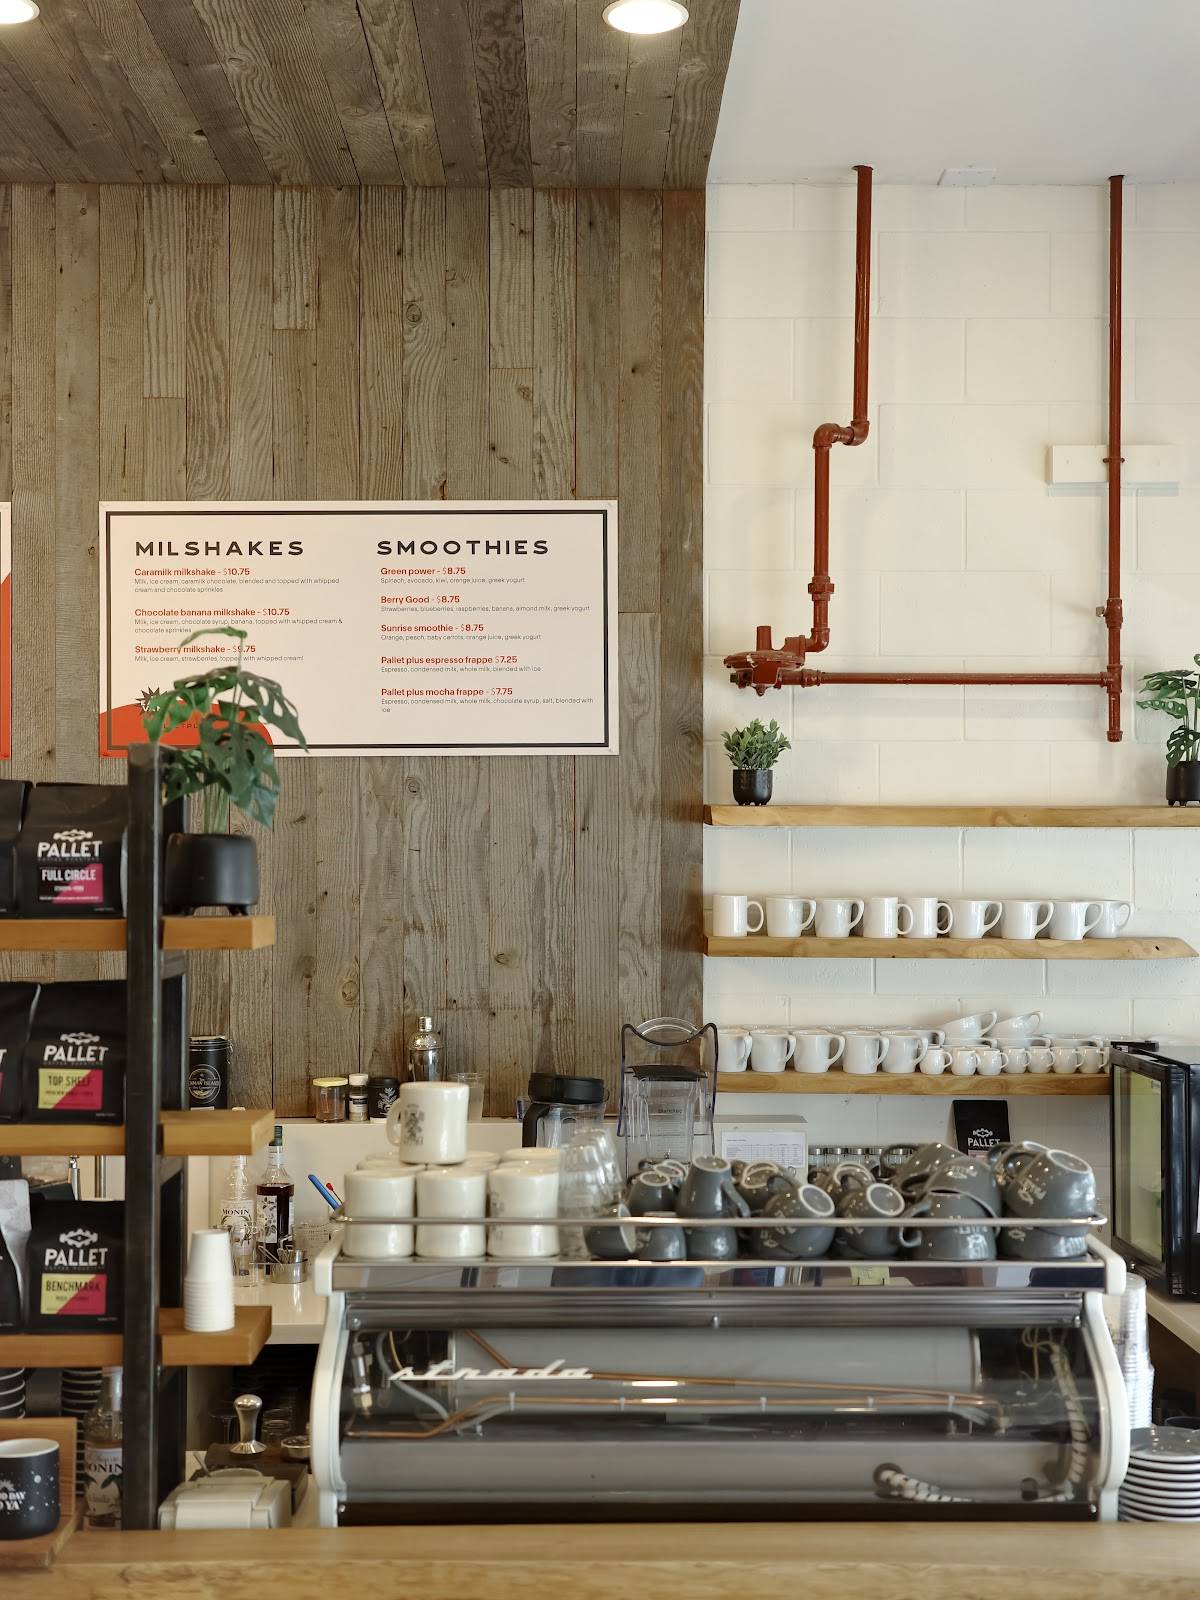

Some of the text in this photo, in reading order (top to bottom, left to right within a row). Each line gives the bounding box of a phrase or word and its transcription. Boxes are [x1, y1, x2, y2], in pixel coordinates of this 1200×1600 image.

[136, 541, 303, 556] MILSHAKES
[377, 540, 548, 555] SMOOTHIES
[223, 567, 250, 576] $10.75
[442, 567, 466, 575] $8.75
[381, 595, 404, 604] Berry
[405, 595, 430, 603] Good
[436, 595, 460, 604] $8.75
[134, 608, 179, 616] Chocolate
[180, 608, 212, 616] banana
[213, 608, 256, 616] milkshake
[262, 608, 290, 617] $10.75
[460, 624, 484, 632] $8.75
[134, 645, 181, 654] Strawberry
[406, 656, 424, 665] plus
[465, 656, 494, 665] frappe
[495, 656, 518, 664] $7.25
[406, 688, 424, 697] plus
[456, 688, 484, 697] frappe
[491, 688, 513, 696] $7.75
[37, 841, 102, 858] PALLET
[42, 869, 96, 881] FULL CIRCLE
[44, 1045, 109, 1062] PALLET
[48, 1075, 63, 1086] TOP
[968, 1138, 1000, 1147] PALLET
[45, 1248, 108, 1266] PALLET
[46, 1281, 100, 1291] BENCHMARK
[84, 1463, 123, 1473] ONIN
[9, 1491, 26, 1500] DAY
